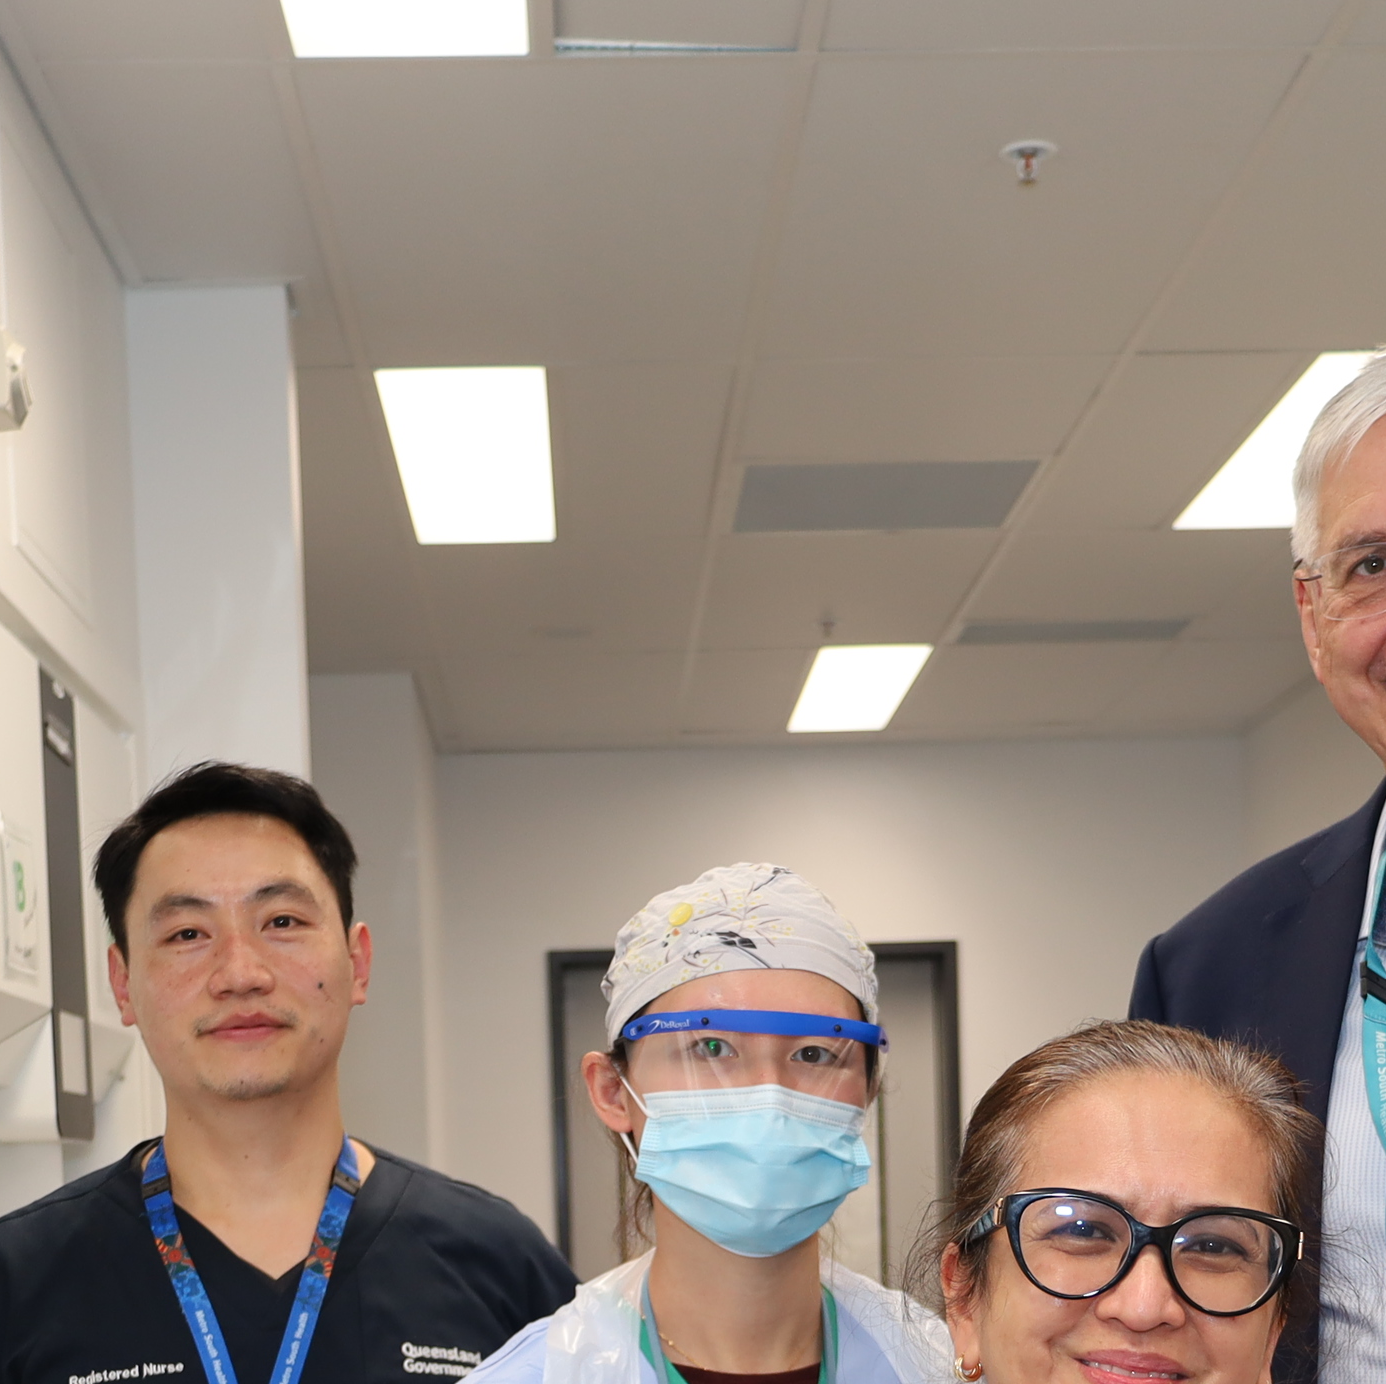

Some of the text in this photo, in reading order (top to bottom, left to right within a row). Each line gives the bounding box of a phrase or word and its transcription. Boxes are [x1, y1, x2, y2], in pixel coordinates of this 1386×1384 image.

[660, 1019, 690, 1030] DeRoyal
[401, 1342, 482, 1365] Queensland
[143, 1362, 185, 1379] Nurse
[403, 1358, 473, 1377] Governme
